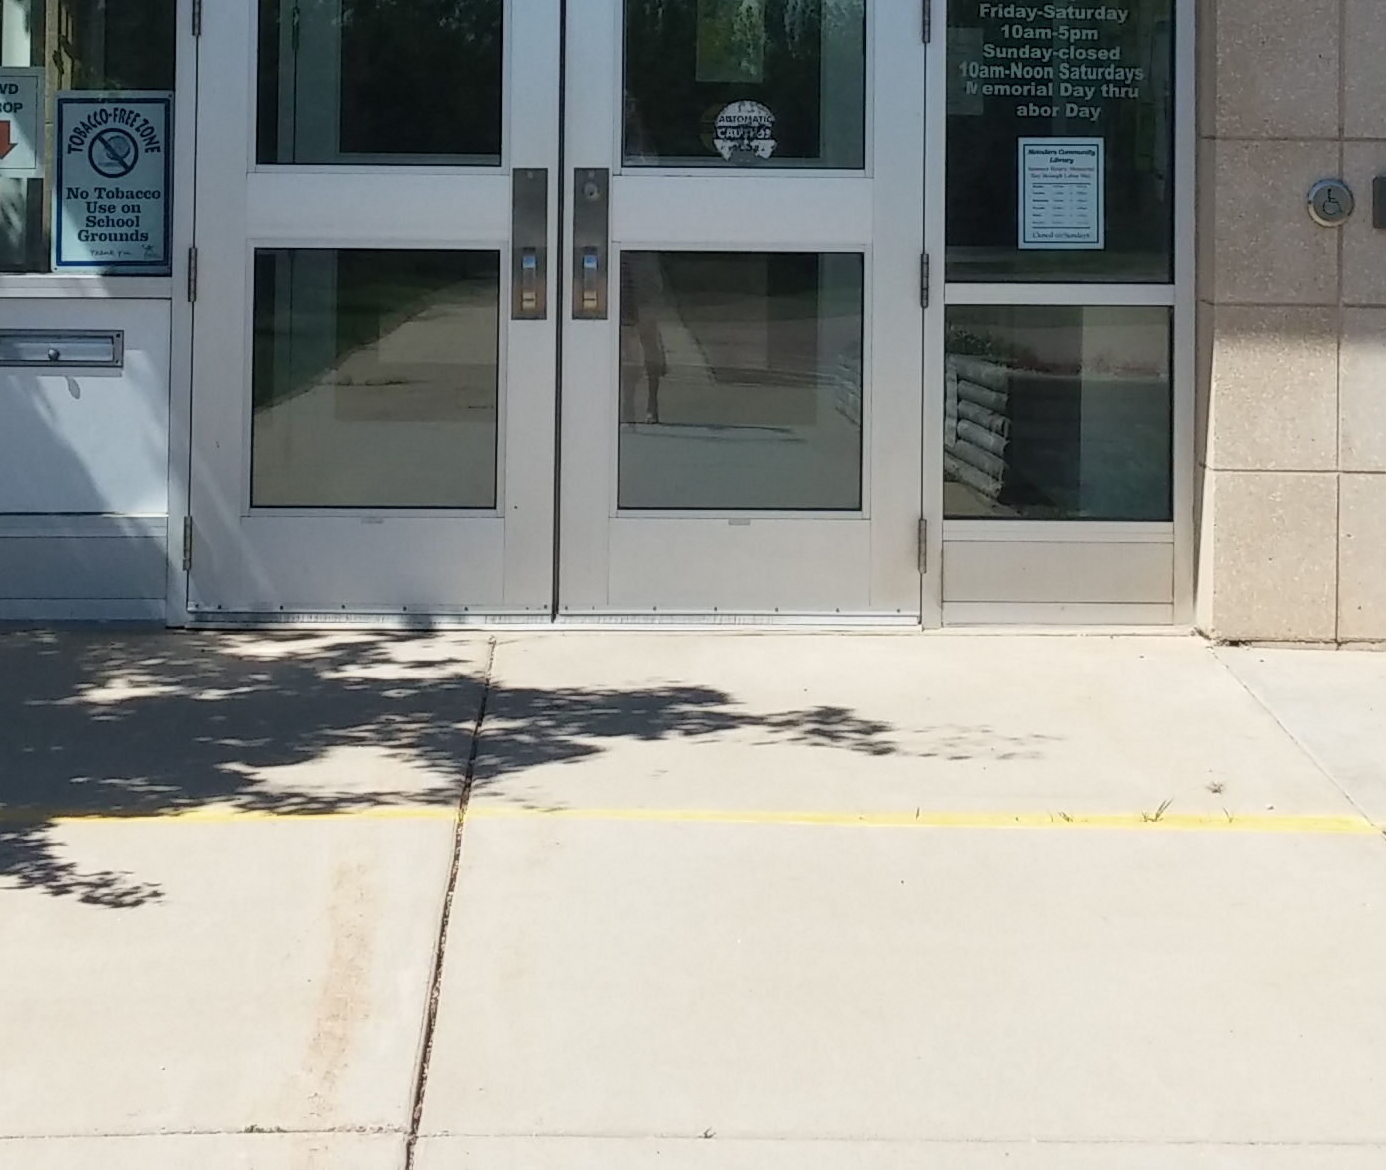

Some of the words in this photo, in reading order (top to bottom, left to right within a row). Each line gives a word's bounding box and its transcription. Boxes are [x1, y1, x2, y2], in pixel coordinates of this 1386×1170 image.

[979, 3, 1129, 24] Friday-Saturday
[1001, 25, 1099, 43] 10am-5pm
[983, 44, 1121, 63] Sunday-closed
[959, 62, 1053, 79] 10am-Noon
[1059, 63, 1144, 84] Saturdays
[1059, 83, 1095, 100] Day
[1101, 84, 1139, 98] thru
[1065, 104, 1101, 121] Day
[68, 107, 141, 154] TOBACCO-FREE
[135, 118, 161, 153] ZONE
[66, 187, 89, 200] No
[94, 187, 161, 200] Tobacco
[86, 201, 116, 214] Use
[122, 204, 142, 214] on
[85, 215, 140, 228] School
[77, 230, 149, 243] Grounds
